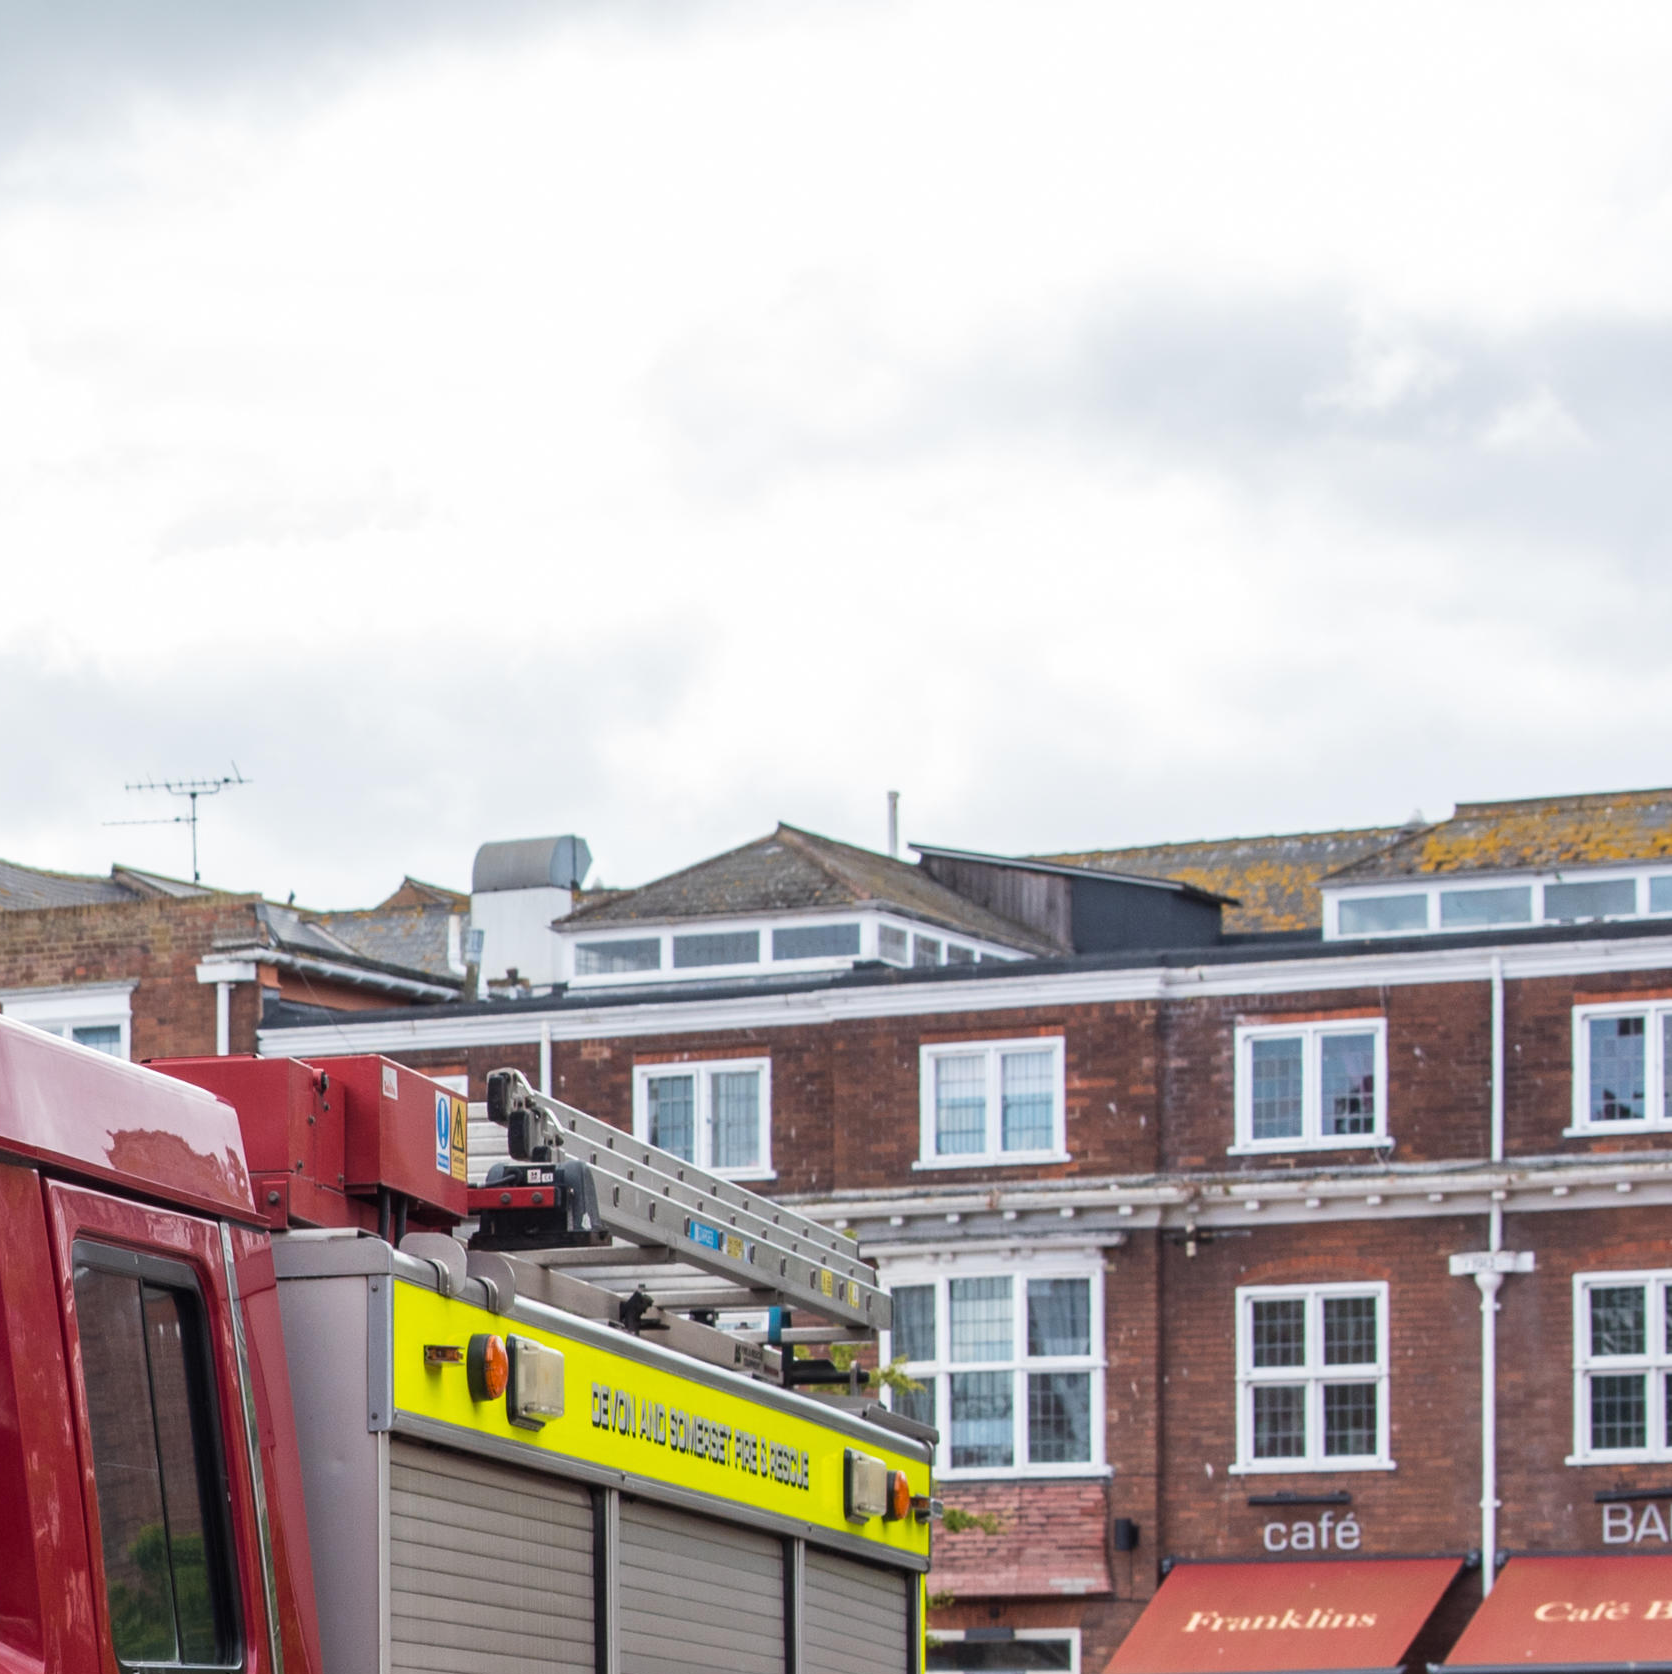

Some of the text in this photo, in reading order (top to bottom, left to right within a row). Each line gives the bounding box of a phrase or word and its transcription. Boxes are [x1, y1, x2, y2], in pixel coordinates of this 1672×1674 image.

[591, 1382, 810, 1491] DEVON AND SOMERSET FIRE & RESCUE
[1262, 1511, 1362, 1552] café
[1602, 1503, 1672, 1544] BA
[1182, 1607, 1378, 1633] Franklins
[1533, 1600, 1632, 1622] Café
